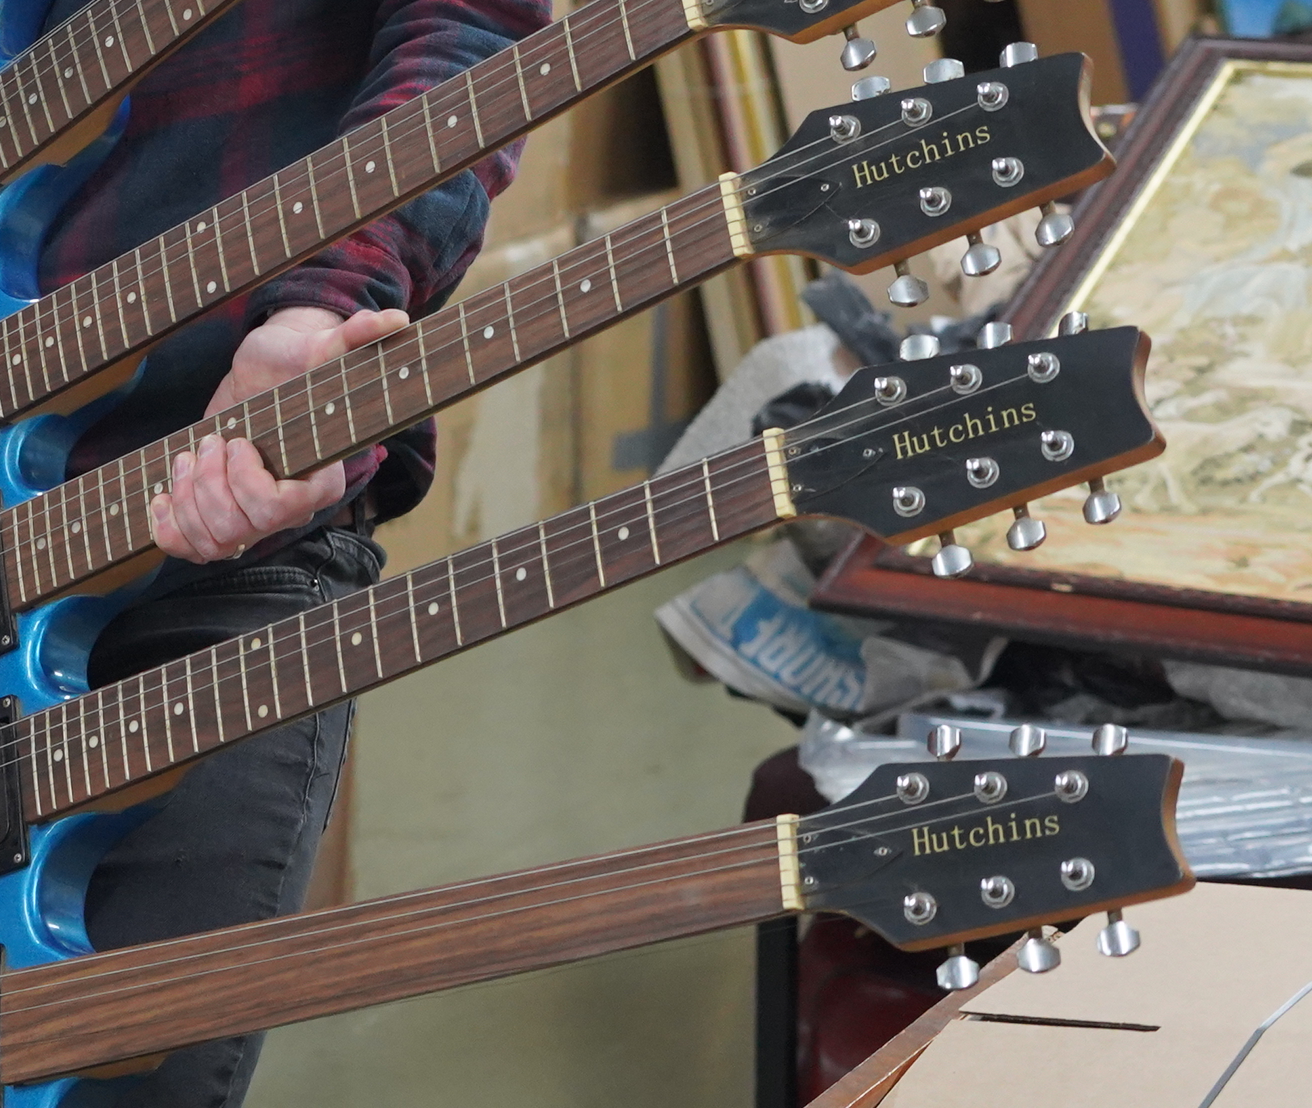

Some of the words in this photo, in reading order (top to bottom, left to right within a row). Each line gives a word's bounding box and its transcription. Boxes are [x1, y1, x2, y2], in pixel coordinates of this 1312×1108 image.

[850, 125, 991, 189] Hutchins
[891, 401, 1037, 460] Hutchins
[911, 812, 1061, 857] Hutchins
